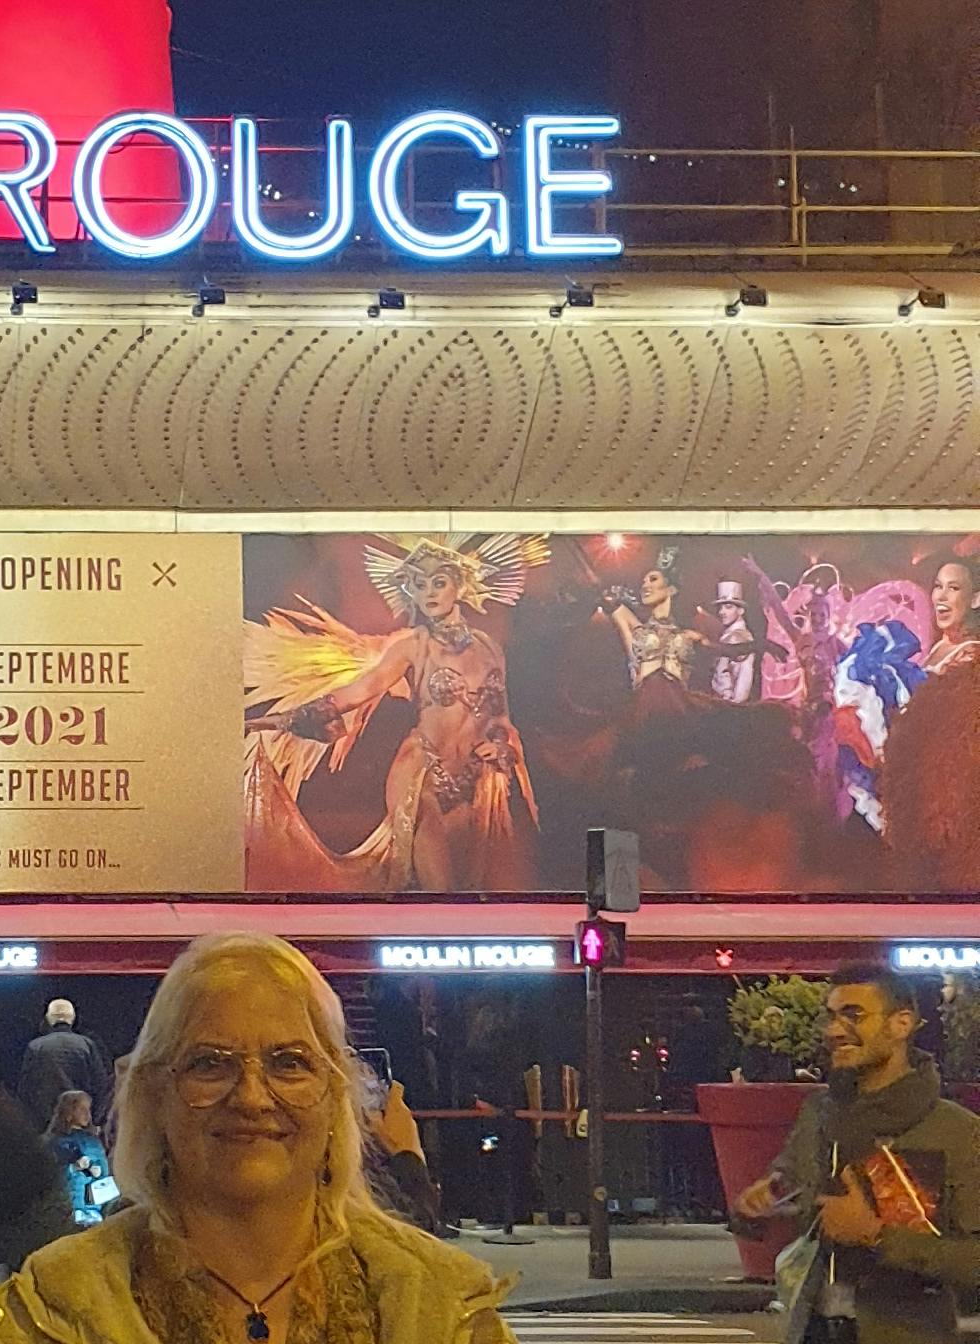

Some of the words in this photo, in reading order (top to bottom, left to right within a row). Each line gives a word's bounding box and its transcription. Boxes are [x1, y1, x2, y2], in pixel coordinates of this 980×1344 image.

[8, 849, 51, 869] MUST
[58, 849, 79, 869] GO
[382, 945, 470, 967] MOULIN
[474, 945, 555, 967] ROUGE
